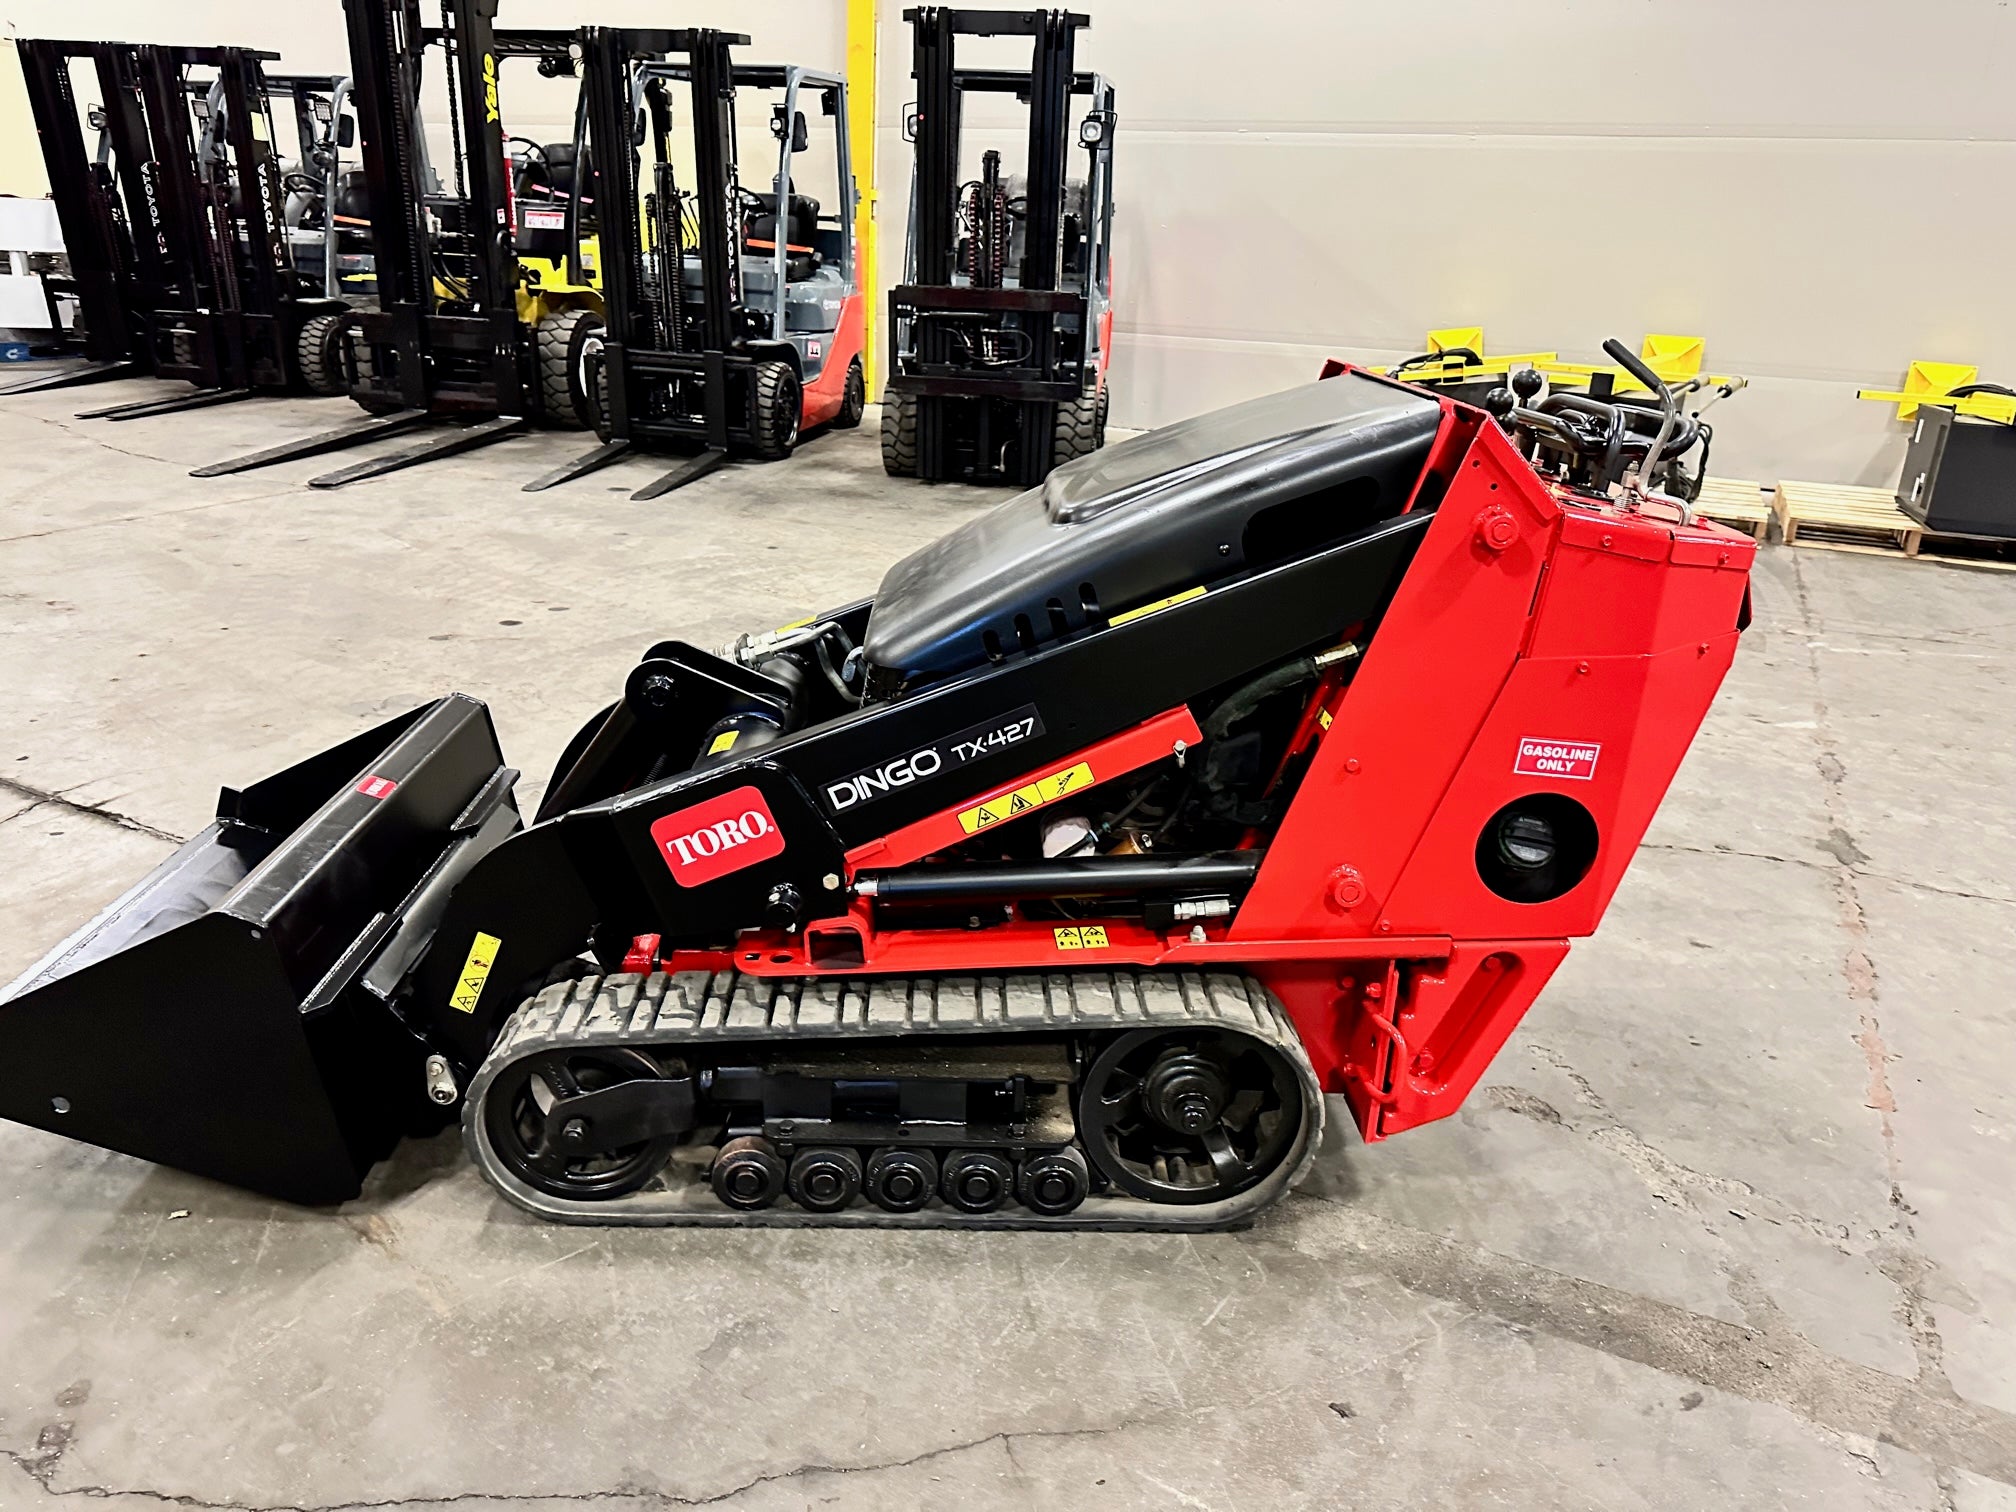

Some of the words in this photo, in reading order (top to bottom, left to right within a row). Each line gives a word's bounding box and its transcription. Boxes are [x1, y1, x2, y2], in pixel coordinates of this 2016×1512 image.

[483, 53, 499, 123] Yale
[140, 162, 160, 227] TOYOTA
[257, 162, 275, 234] TOYOTA
[724, 182, 735, 269] TOYOTA
[827, 747, 941, 810] DINGO
[1522, 744, 1595, 761] GASOLINE
[1536, 758, 1575, 772] ONLY
